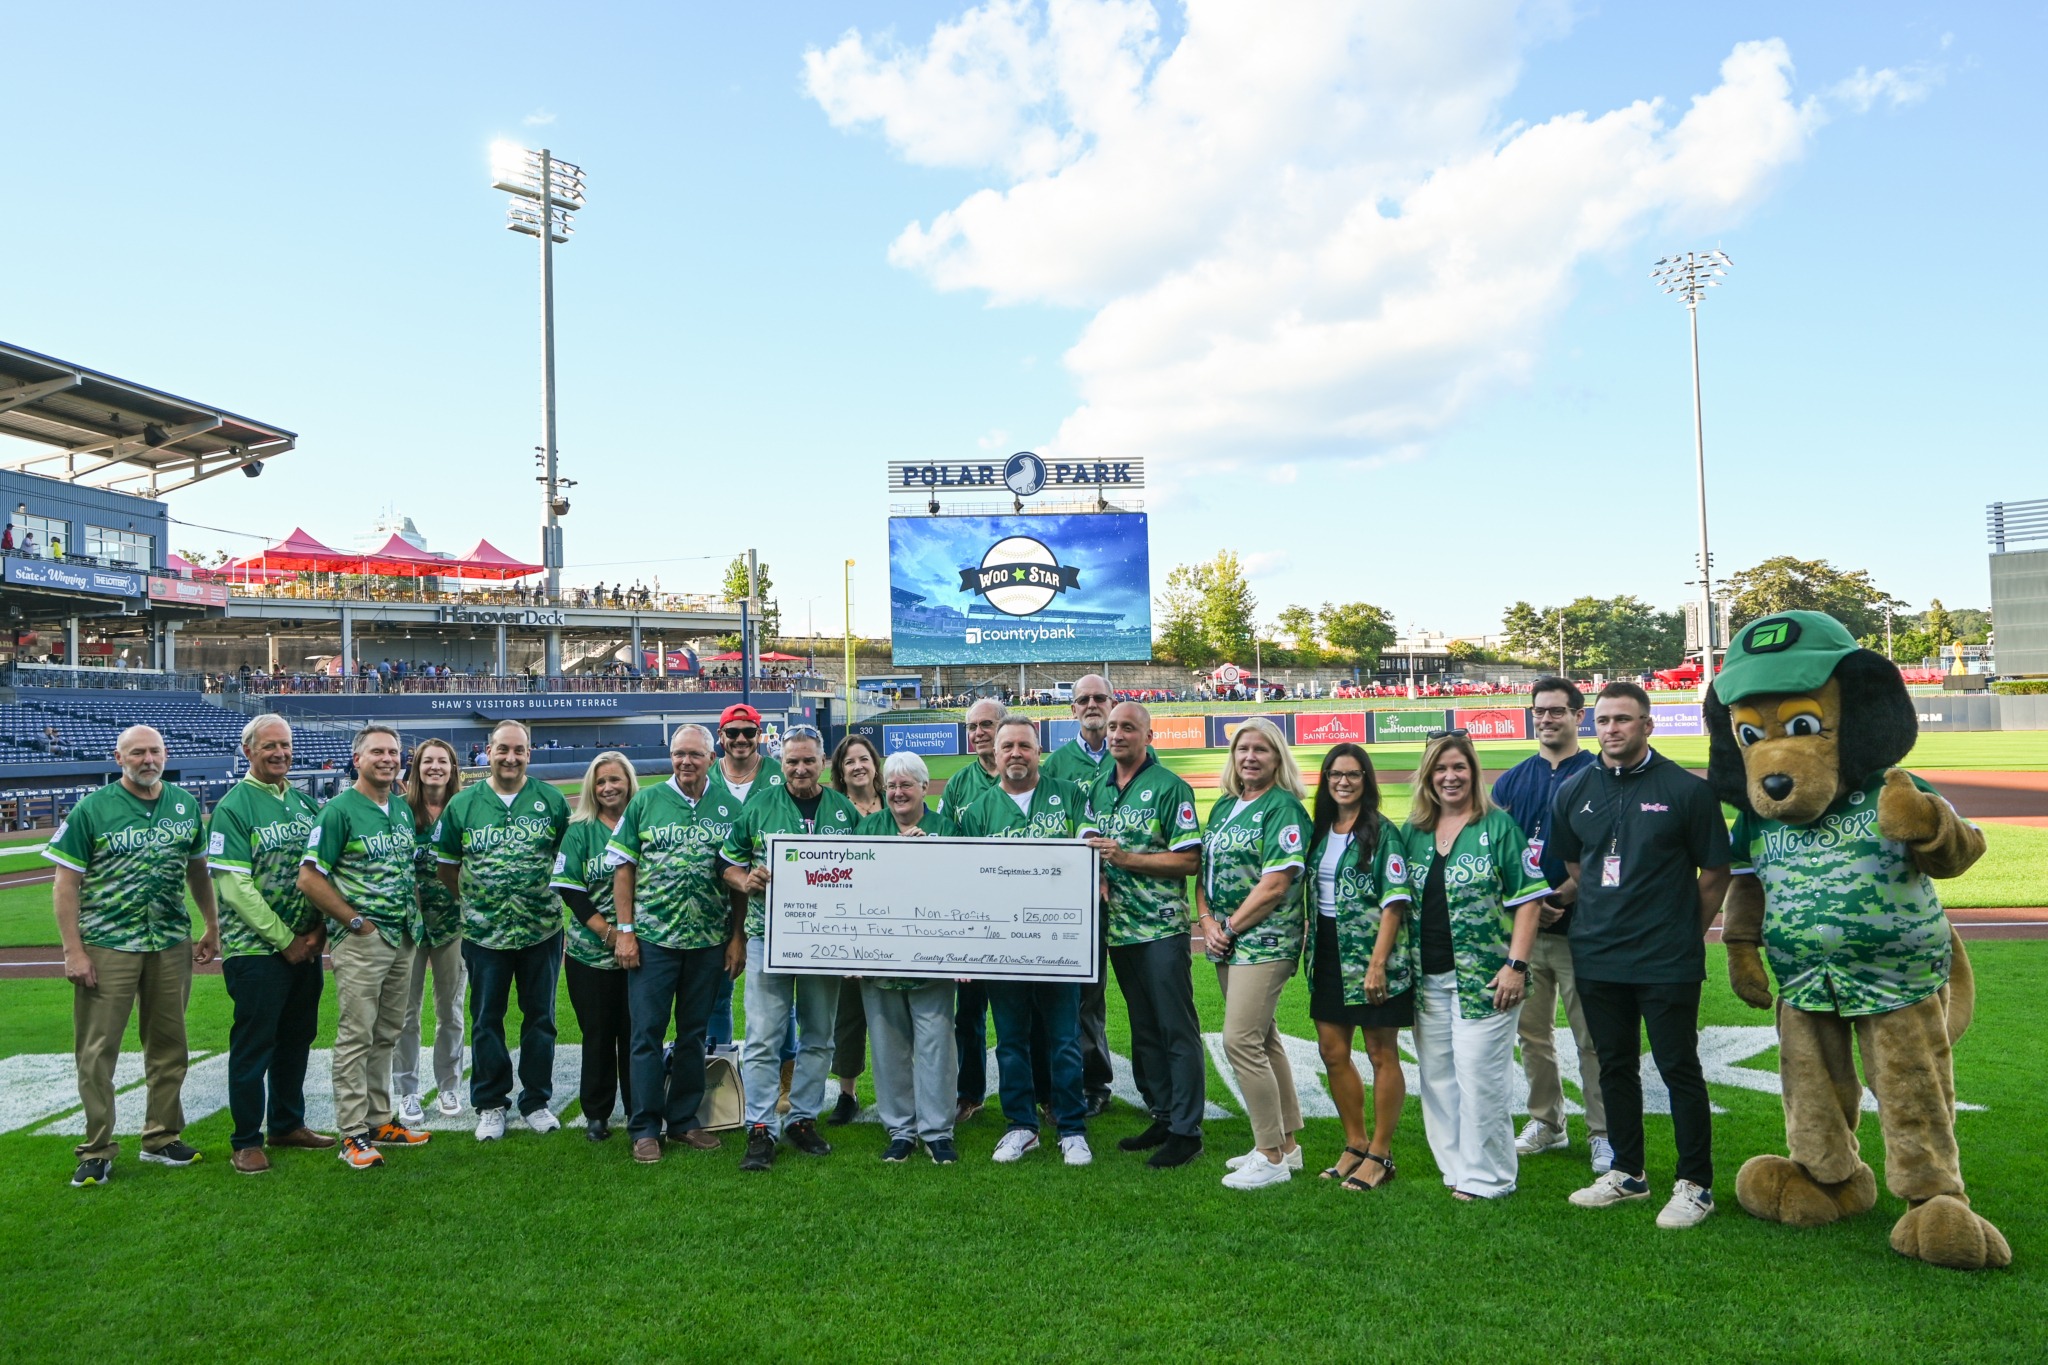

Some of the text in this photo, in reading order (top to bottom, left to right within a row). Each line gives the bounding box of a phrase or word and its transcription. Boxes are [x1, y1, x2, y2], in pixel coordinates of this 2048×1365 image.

[902, 463, 1132, 486] POLAR PARK
[15, 568, 40, 582] State
[48, 568, 87, 589] Winning
[176, 581, 204, 596] Manny's
[441, 606, 564, 626] Hanover Deck
[1688, 603, 1696, 649] OSTROW
[983, 624, 1076, 643] countrybank
[432, 698, 618, 709] SHAW'S VISITORS BULLPEN TERRACE
[1675, 713, 1698, 721] Chan
[1917, 713, 1942, 722] RM
[860, 727, 873, 735] 330
[1154, 727, 1202, 740] onhealth
[1465, 719, 1515, 734] Table Talk
[905, 731, 953, 741] Assumption
[1303, 732, 1359, 740] SAINT-GOBAIN
[905, 739, 946, 749] University
[102, 817, 195, 857] WooSox
[465, 814, 552, 852] WooSox
[1761, 809, 1876, 863] WooSox
[799, 848, 876, 863] countrybank
[804, 867, 853, 885] WooSox
[998, 866, 1031, 877] September
[1050, 867, 1062, 876] 25
[835, 903, 847, 916] 5
[859, 903, 890, 916] Local
[1013, 914, 1019, 922] $
[867, 923, 895, 935] Five
[902, 925, 965, 936] Thousand
[810, 944, 894, 960] 2025 WooStar
[913, 952, 1079, 966] Country Bank and The WooSox Foundation
